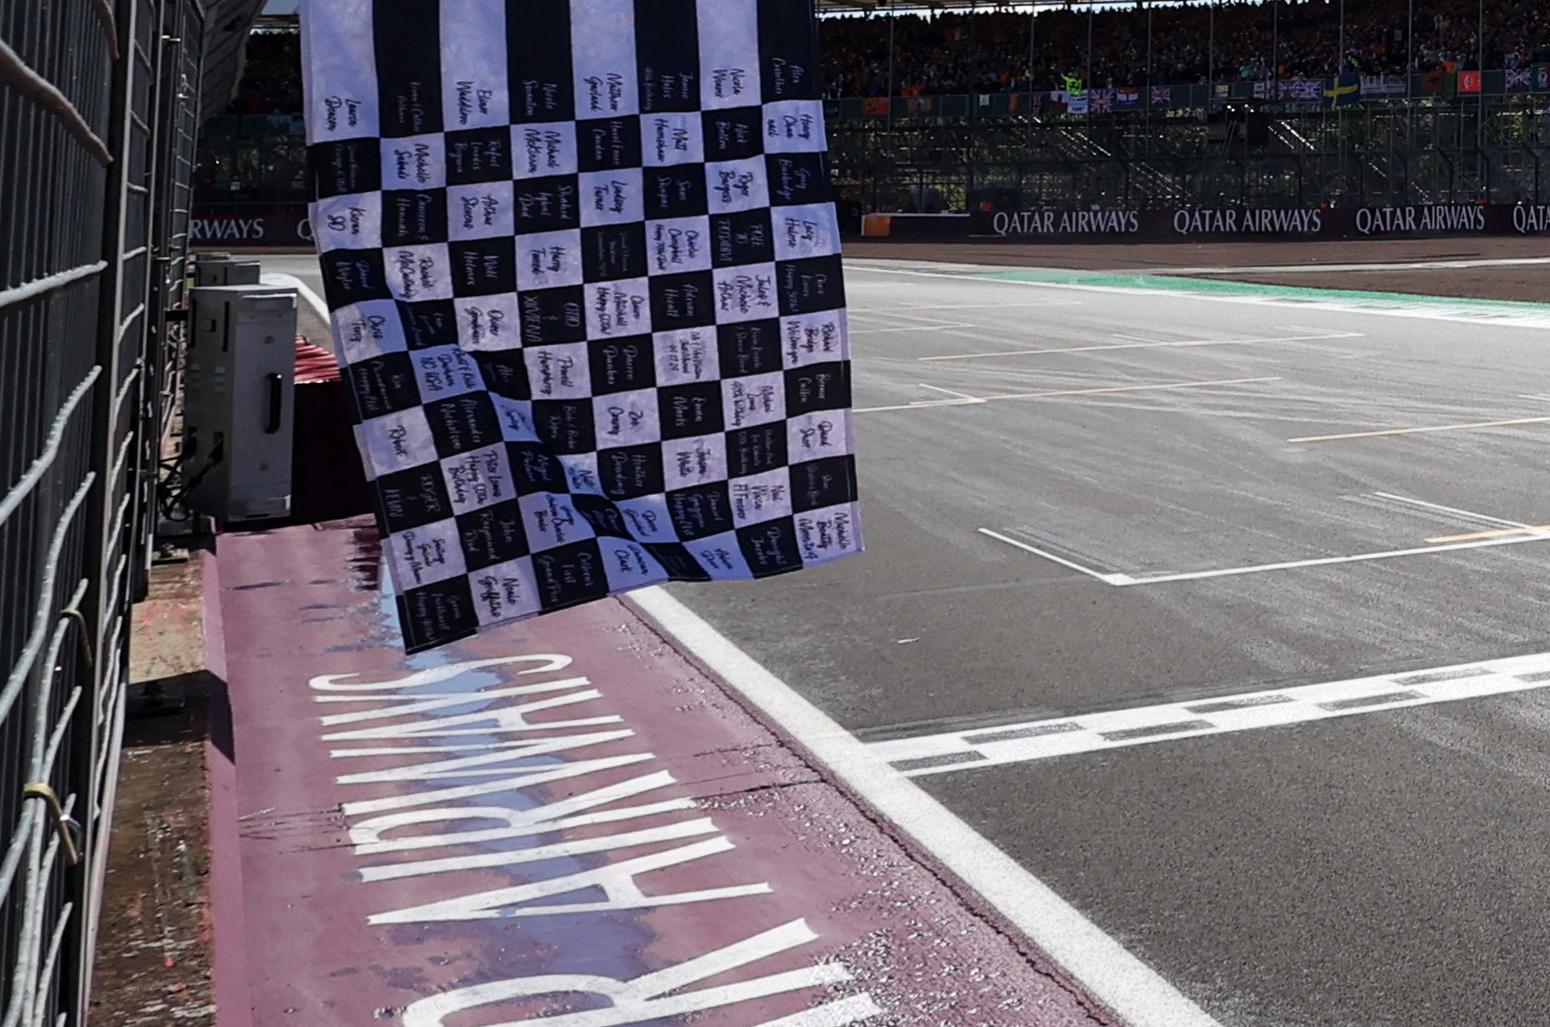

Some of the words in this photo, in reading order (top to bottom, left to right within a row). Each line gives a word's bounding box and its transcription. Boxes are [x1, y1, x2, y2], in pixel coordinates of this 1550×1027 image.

[993, 211, 1054, 233] QATAR
[1058, 210, 1139, 233] AIRWAYS
[1173, 210, 1237, 234] QATAR
[1241, 209, 1321, 233] AIRWAYS
[1356, 208, 1415, 232] QATAR
[1419, 206, 1485, 230] AIRWAYS
